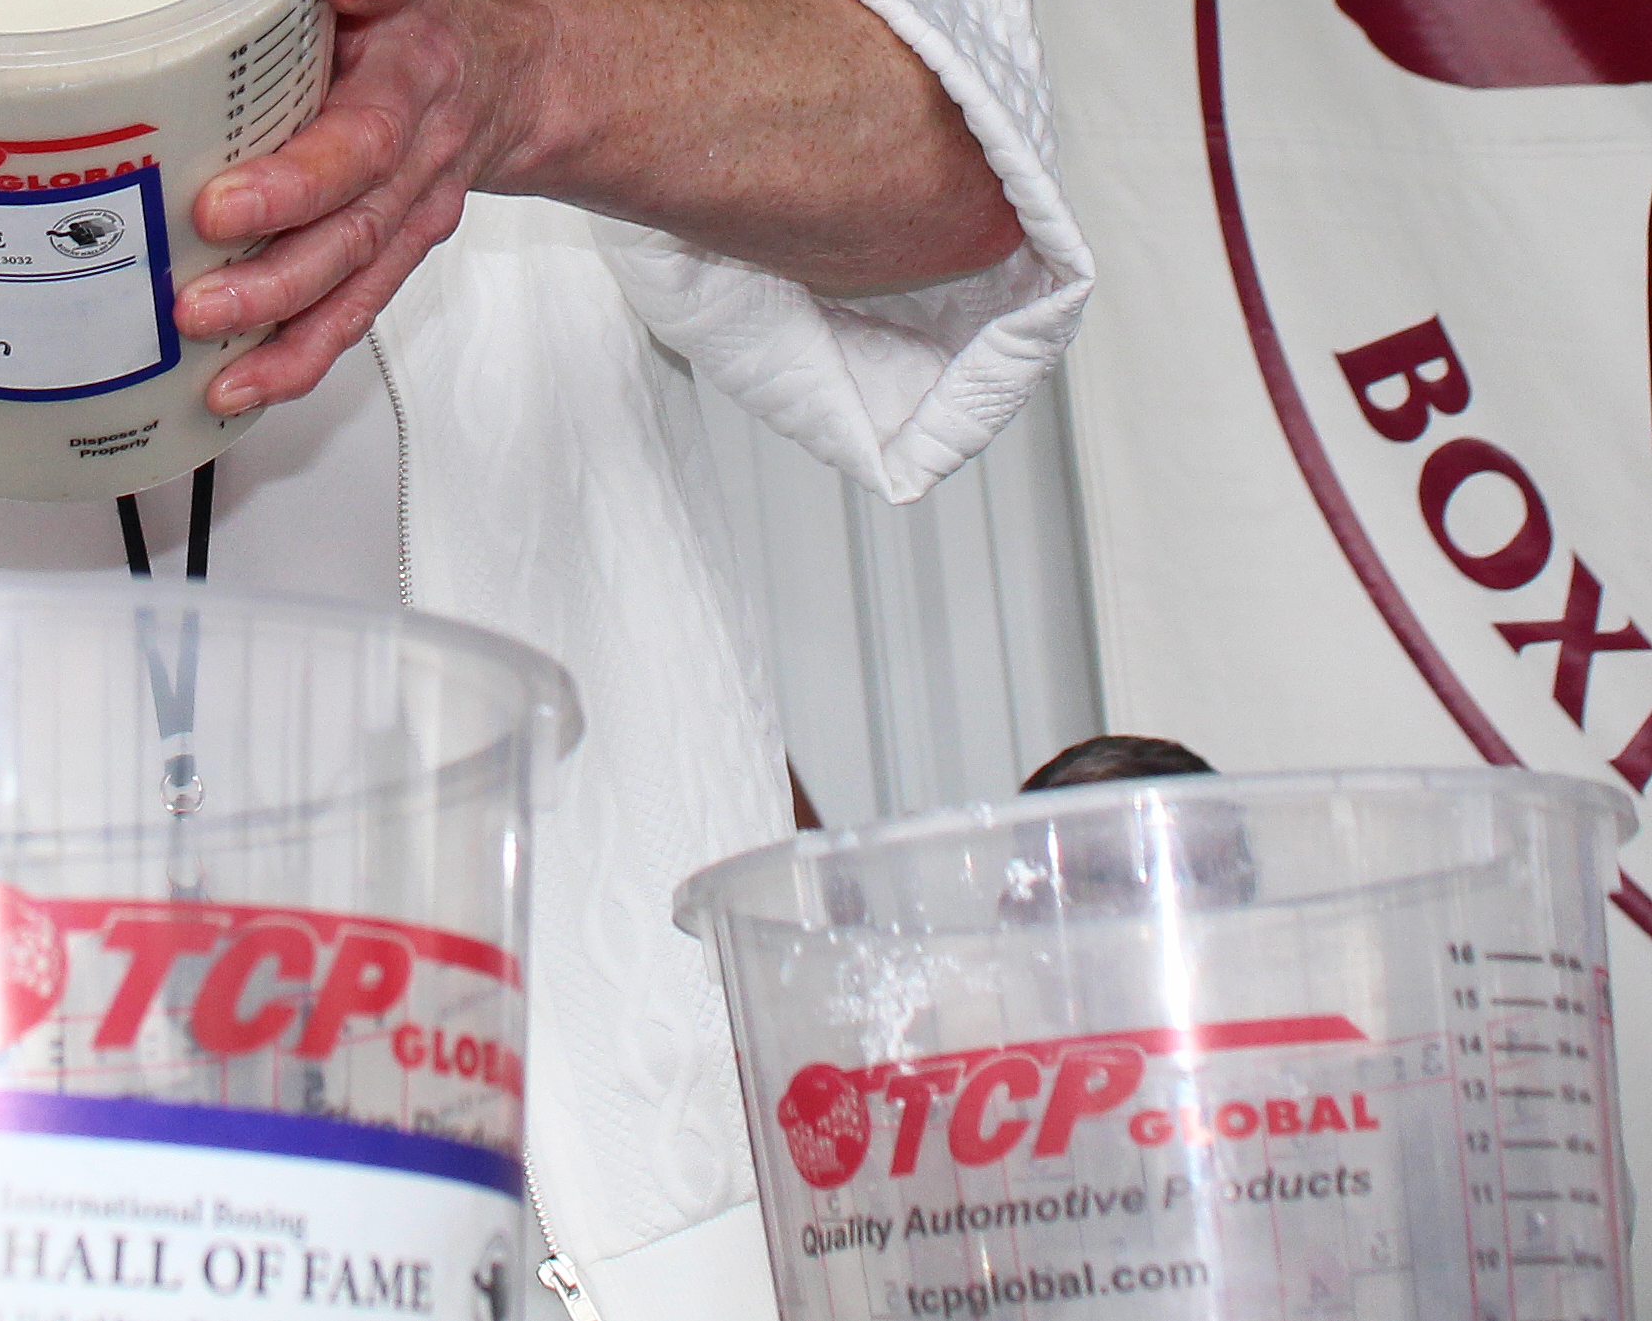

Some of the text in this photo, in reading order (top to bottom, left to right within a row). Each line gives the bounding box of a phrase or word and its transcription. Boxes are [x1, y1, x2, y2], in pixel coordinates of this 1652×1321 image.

[228, 43, 248, 62] 16
[228, 62, 248, 81] 15
[227, 83, 246, 101] 14
[226, 103, 245, 121] 13
[225, 125, 244, 142] 12
[224, 148, 241, 163] 11
[69, 418, 160, 449] Dispose of
[79, 436, 151, 460] Properly
[90, 910, 415, 1060] TCP
[390, 1019, 526, 1100] GLO
[884, 1044, 1381, 1179] TCP GLOBAL
[1, 1184, 309, 1242] International Boxing
[802, 1165, 1374, 1258] Quality Automotive Poducts
[3, 1227, 436, 1315] HALL OF FAME
[907, 1259, 1210, 1321] tcpglobal.com
